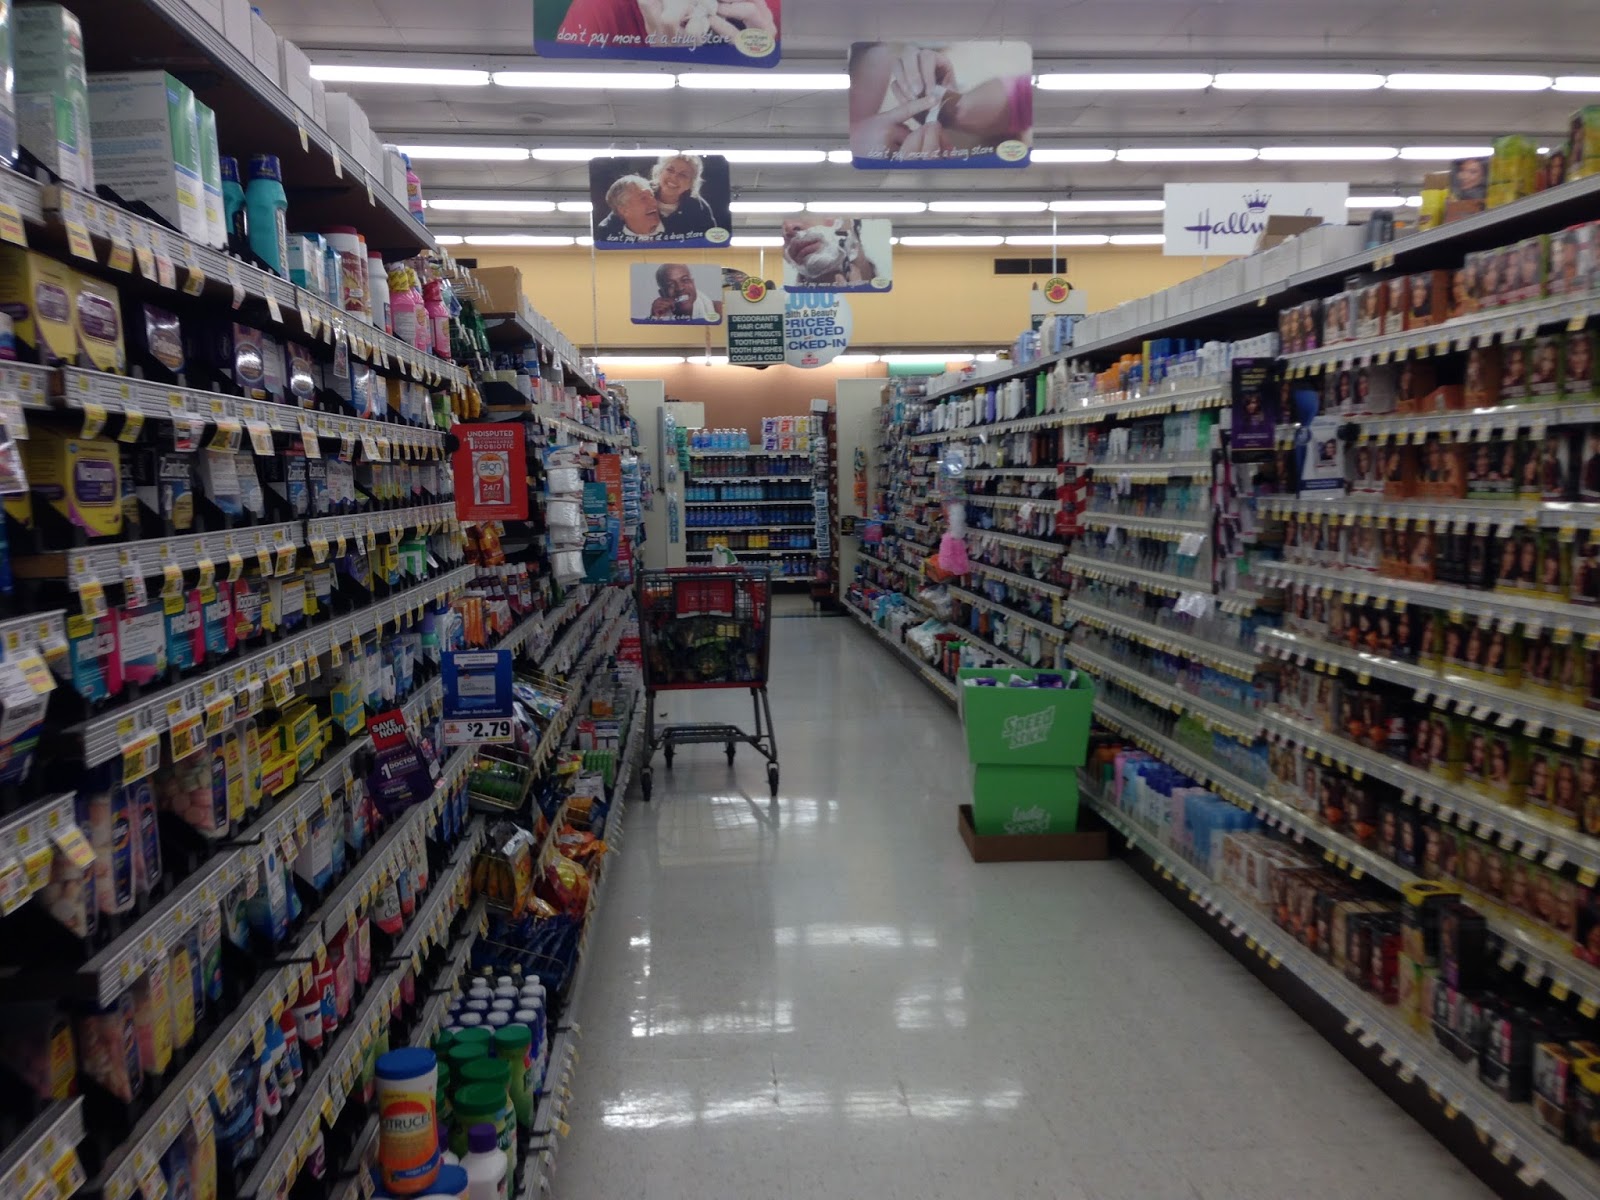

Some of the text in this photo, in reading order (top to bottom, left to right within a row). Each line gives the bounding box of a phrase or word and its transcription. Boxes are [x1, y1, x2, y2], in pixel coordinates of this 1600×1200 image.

[557, 24, 587, 42] don't
[588, 32, 610, 48] pay
[612, 33, 641, 45] more
[645, 33, 657, 45] at
[660, 35, 668, 45] a
[670, 32, 696, 51] drug
[700, 32, 731, 44] store
[890, 150, 904, 162] pay
[908, 151, 929, 159] more
[950, 148, 970, 161] drug
[971, 145, 993, 155] store
[606, 231, 624, 241] don't
[624, 234, 636, 244] pay
[669, 232, 685, 242] drug
[686, 230, 703, 239] store
[785, 309, 837, 318] alth & Beauty
[785, 326, 844, 338] EDUCED
[734, 338, 779, 346] TOOTHPASTE
[787, 338, 847, 350] CKED-IN
[480, 462, 502, 475] align
[372, 719, 397, 733] SAVE
[380, 724, 405, 739] NOW!
[467, 721, 511, 737] $2.79
[389, 755, 417, 769] DOCTOR
